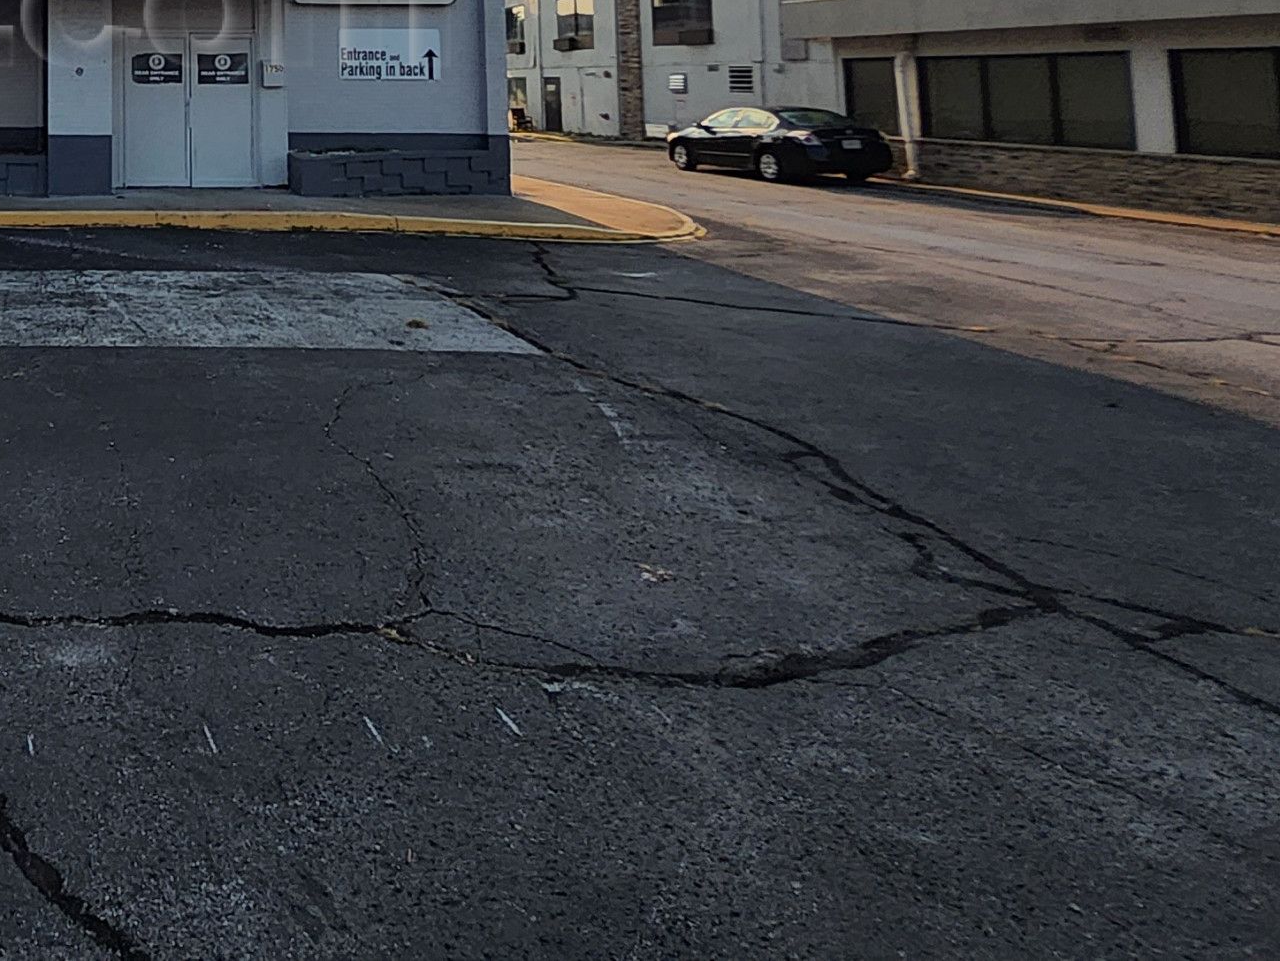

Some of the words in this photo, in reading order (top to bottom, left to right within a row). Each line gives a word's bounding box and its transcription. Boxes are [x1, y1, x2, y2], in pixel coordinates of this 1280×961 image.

[341, 48, 387, 61] Entrance
[341, 62, 382, 80] Parking
[386, 62, 396, 76] in
[400, 62, 426, 76] back
